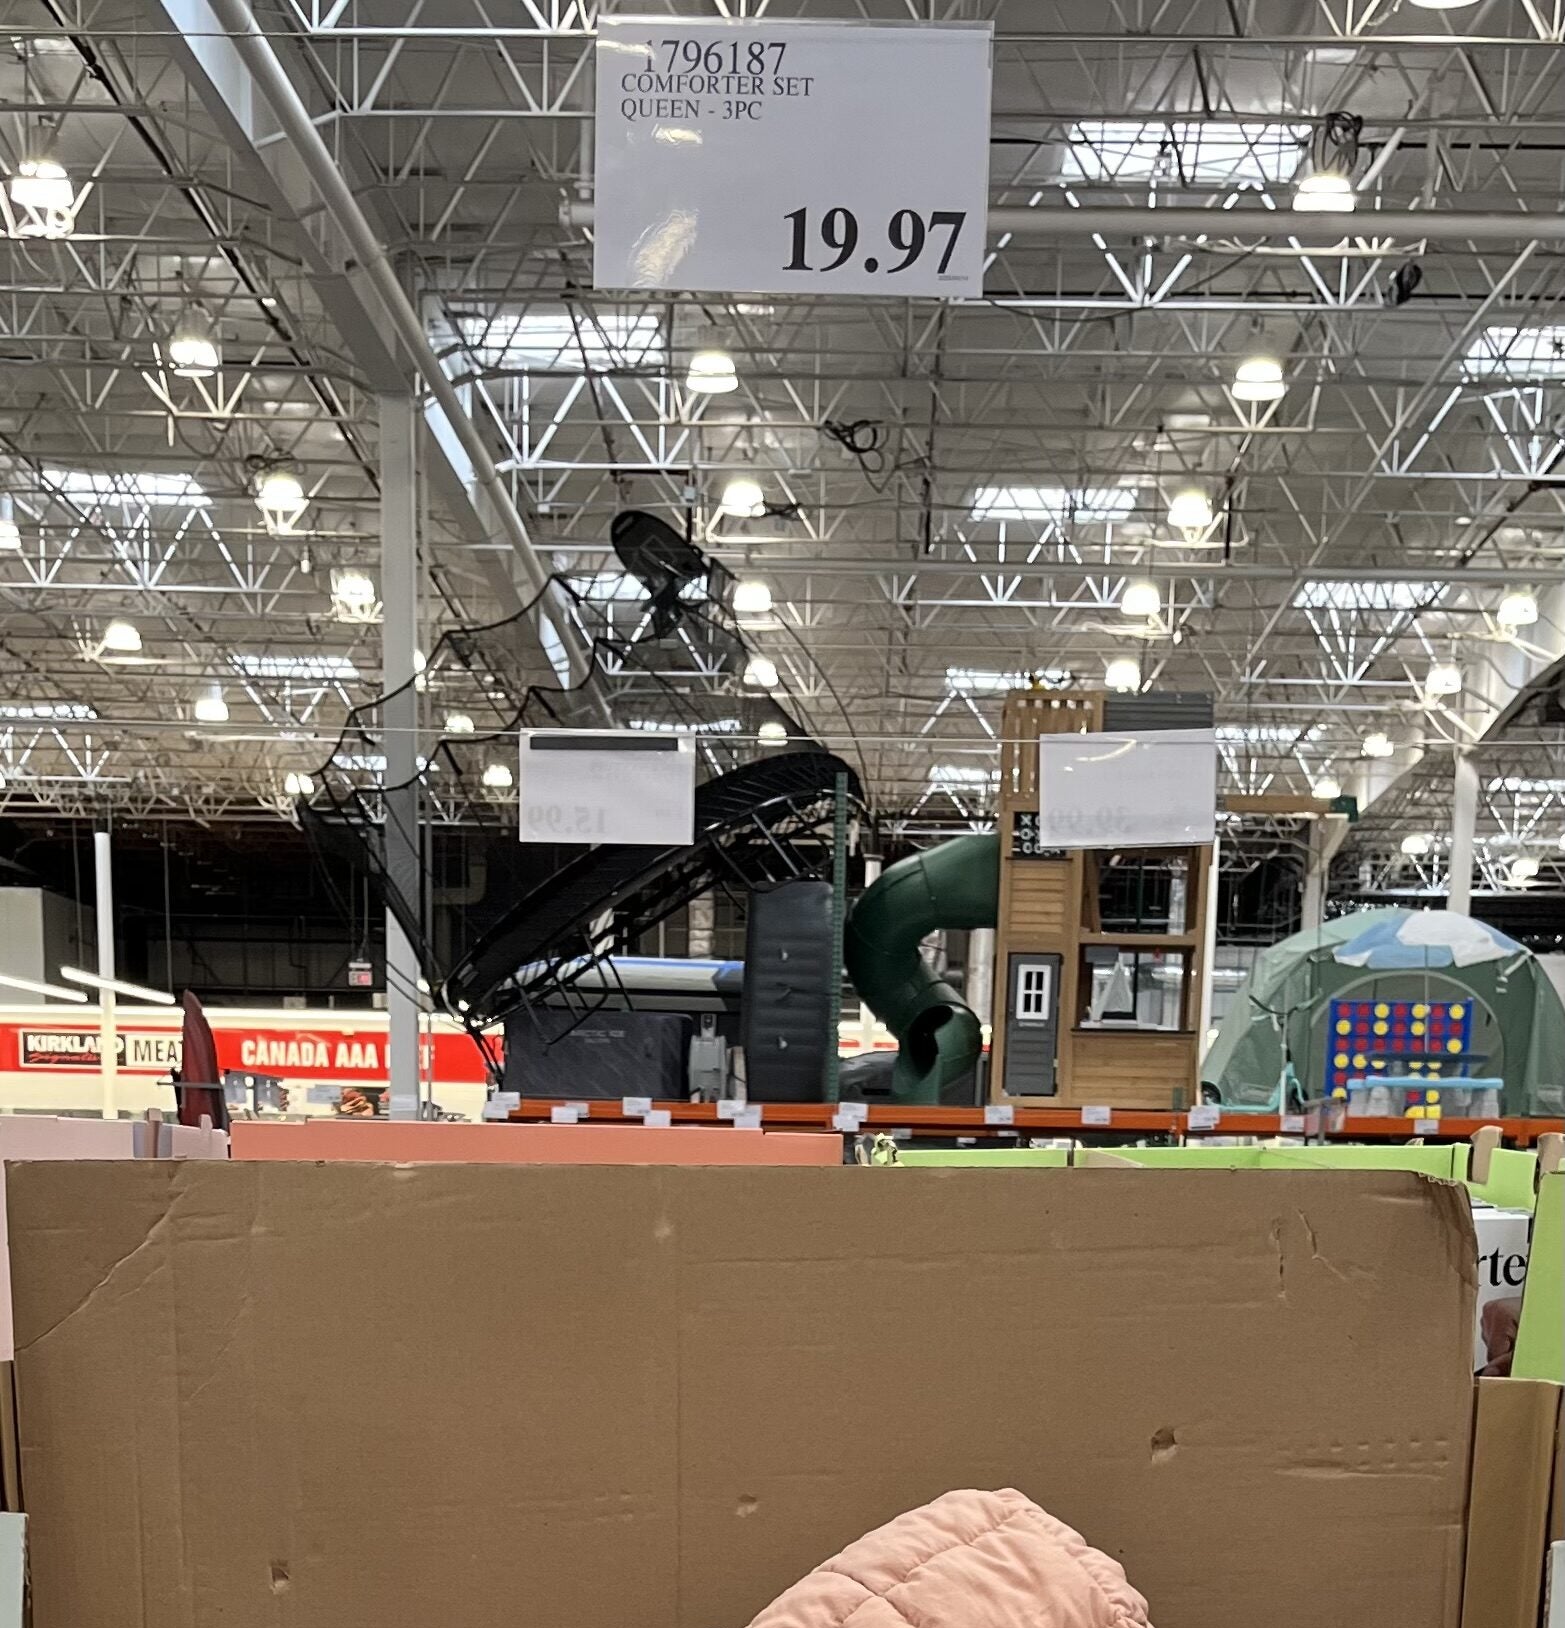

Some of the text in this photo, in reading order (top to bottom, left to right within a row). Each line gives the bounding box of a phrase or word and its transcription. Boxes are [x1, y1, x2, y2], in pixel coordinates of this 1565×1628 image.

[643, 39, 787, 76] 1796187
[621, 73, 814, 96] COMFORTER SET
[621, 98, 700, 121] QUEEN
[722, 100, 763, 120] 3PC
[782, 206, 967, 275] 19.97
[241, 1039, 329, 1068] CANADA
[335, 1043, 378, 1069] AAA
